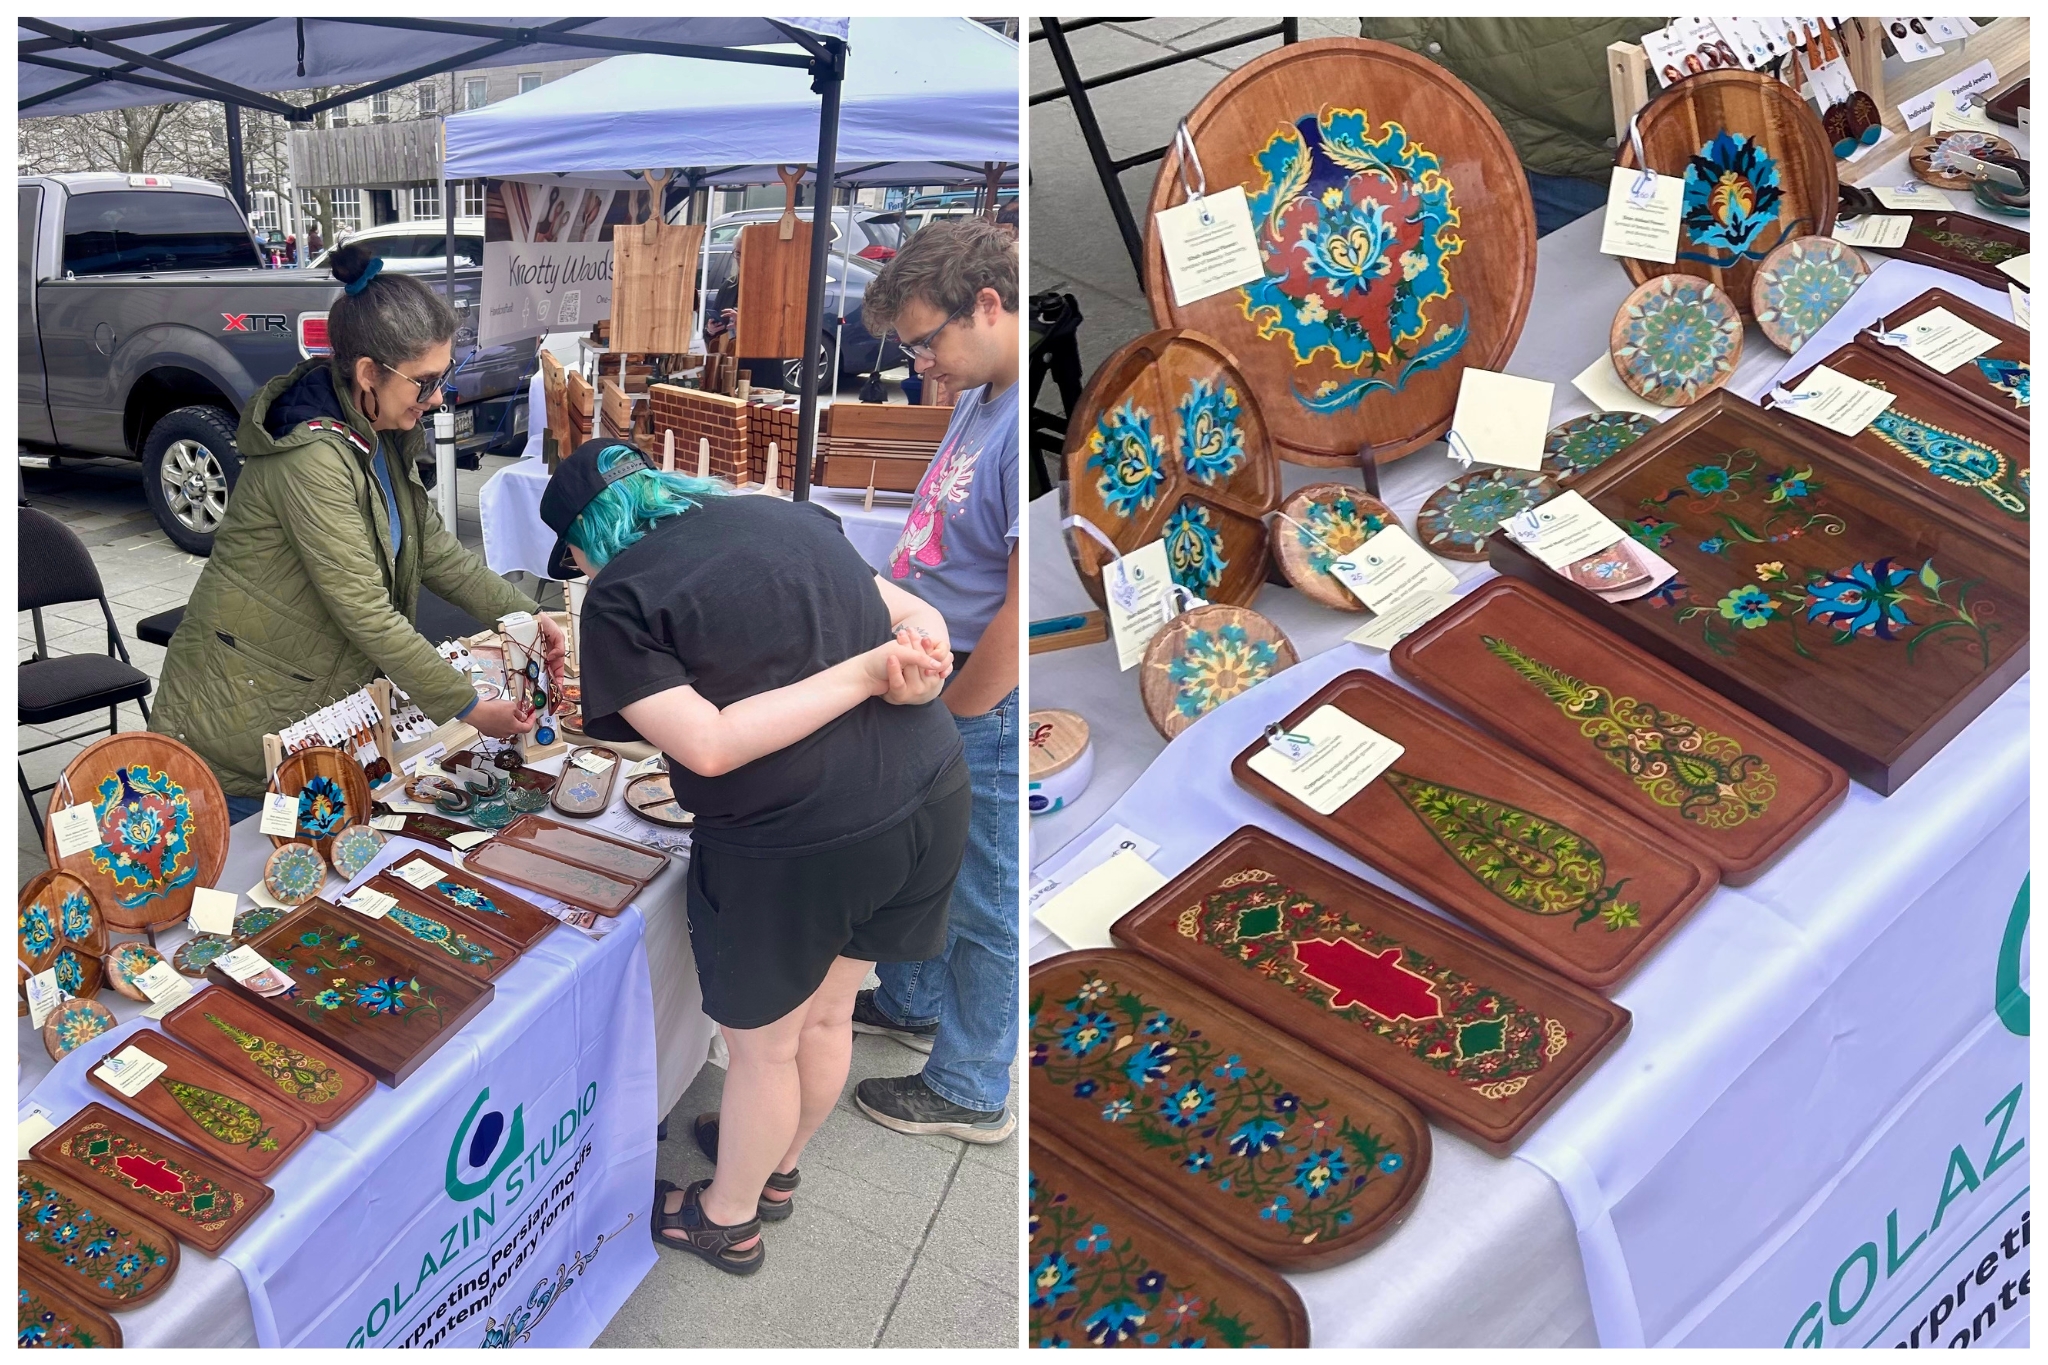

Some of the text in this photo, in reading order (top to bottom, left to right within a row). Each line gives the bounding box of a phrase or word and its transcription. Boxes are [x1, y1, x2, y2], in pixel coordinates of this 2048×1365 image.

[508, 249, 614, 294] Knotty Woods
[221, 313, 292, 332] XTR
[346, 1081, 598, 1349] GOLAZIN STUDIO
[491, 1192, 549, 1271] Persian
[551, 1142, 593, 1196] motifs
[540, 1190, 575, 1237] form
